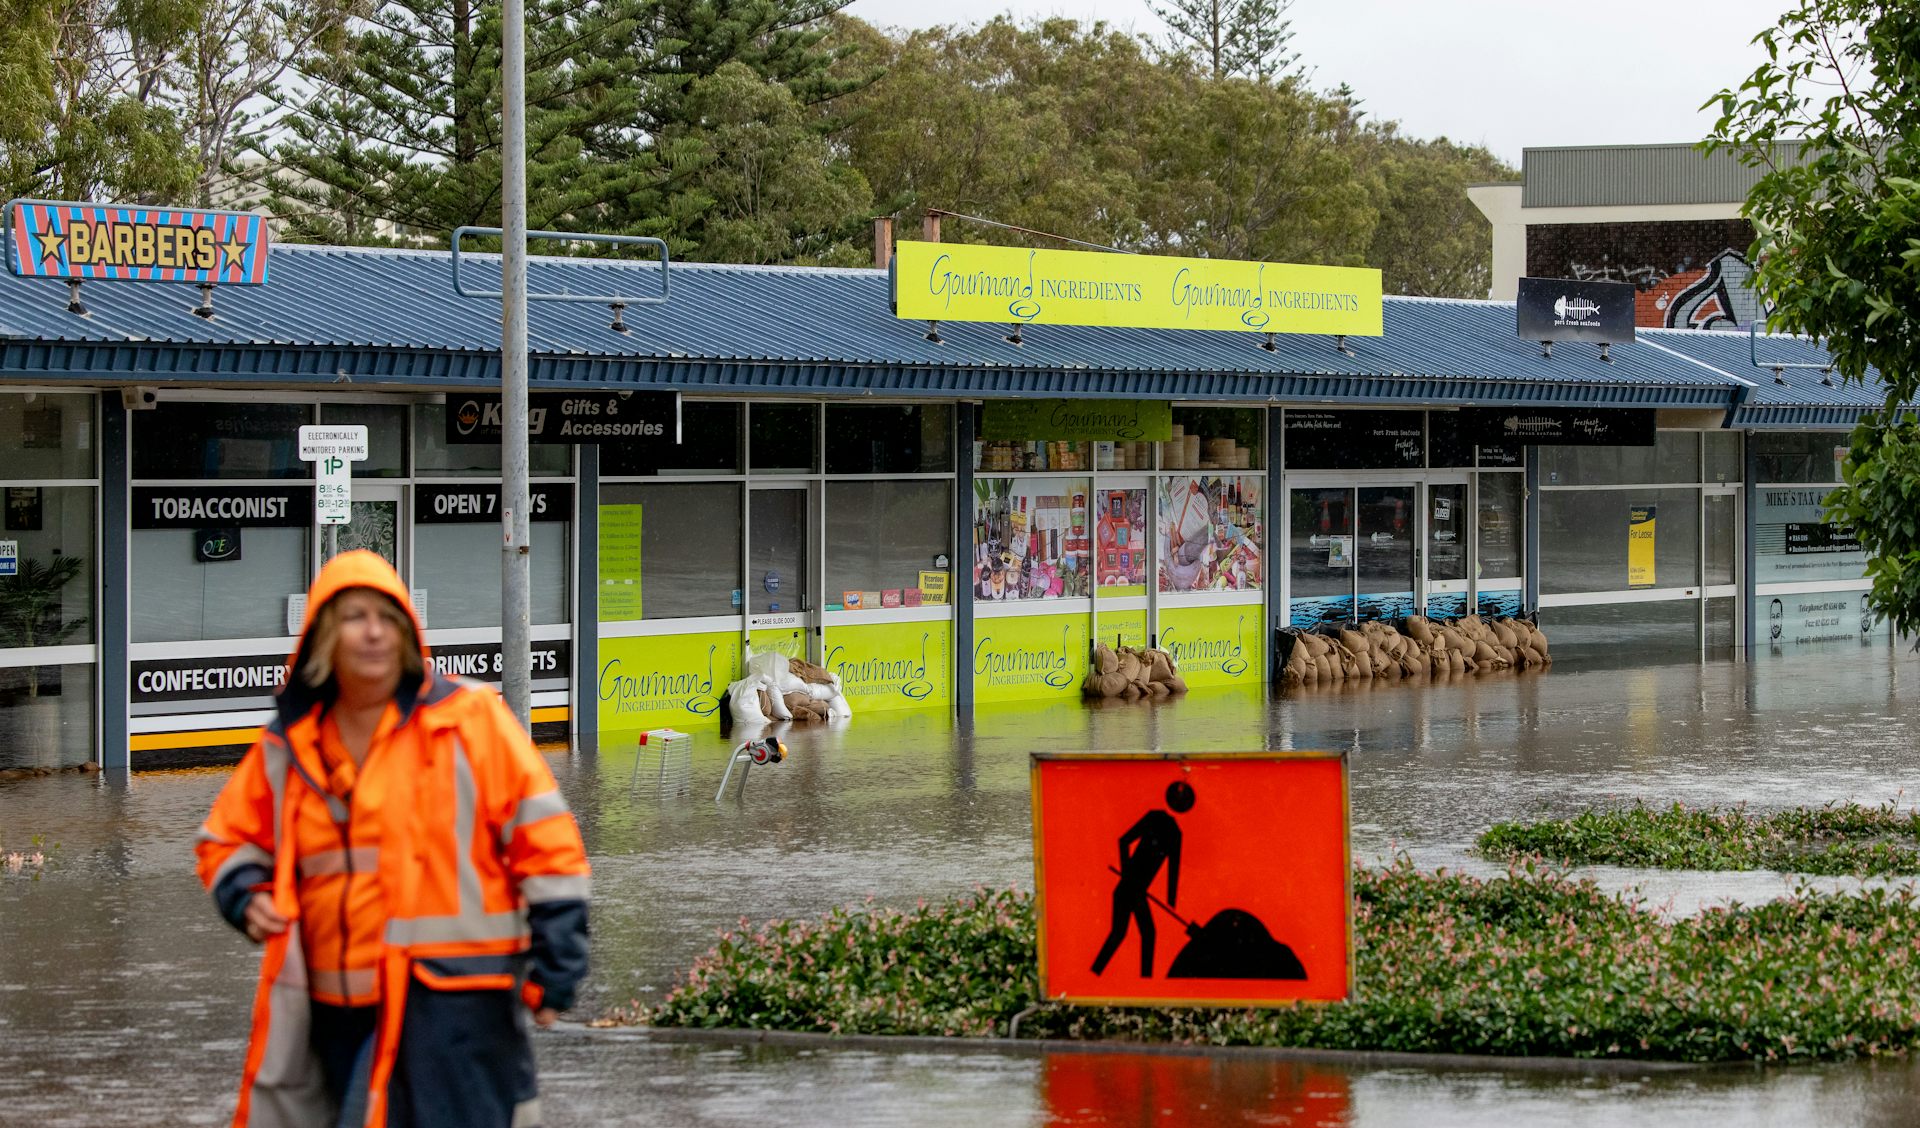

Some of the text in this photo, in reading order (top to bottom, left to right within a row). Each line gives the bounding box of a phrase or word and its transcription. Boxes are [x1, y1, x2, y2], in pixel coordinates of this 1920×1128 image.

[69, 220, 217, 270] BARBERS
[930, 250, 1359, 320] Gourmand INGREDIENTS Gourmand INGREDIENTS
[481, 399, 618, 434] Kg Gifts &
[1050, 400, 1139, 434] Gourmand
[308, 432, 358, 440] ELECTRONICALLY
[560, 419, 663, 436] Accessories
[303, 446, 336, 454] MONITORED
[324, 459, 343, 475] 1P
[434, 493, 547, 515] OPEN 7 YS
[1113, 499, 1121, 509] T2
[1766, 489, 1796, 506] MIKE'S
[1798, 492, 1814, 506] TAX
[152, 497, 288, 519] TOBACCONIST
[1435, 508, 1449, 518] CLOSED
[1639, 530, 1653, 539] Lease
[1122, 554, 1129, 562] T2
[1159, 615, 1244, 662] Gourmand
[530, 650, 557, 671] FTS
[825, 633, 928, 693] Gourmand
[974, 624, 1069, 687] Gourmand
[1177, 661, 1221, 673] NGREDIENTS
[599, 644, 716, 714] Gourmand
[992, 672, 1044, 686] INGREDIENTS
[845, 683, 901, 697] INGREDIENTS
[622, 698, 686, 712] INGREDIENTS
